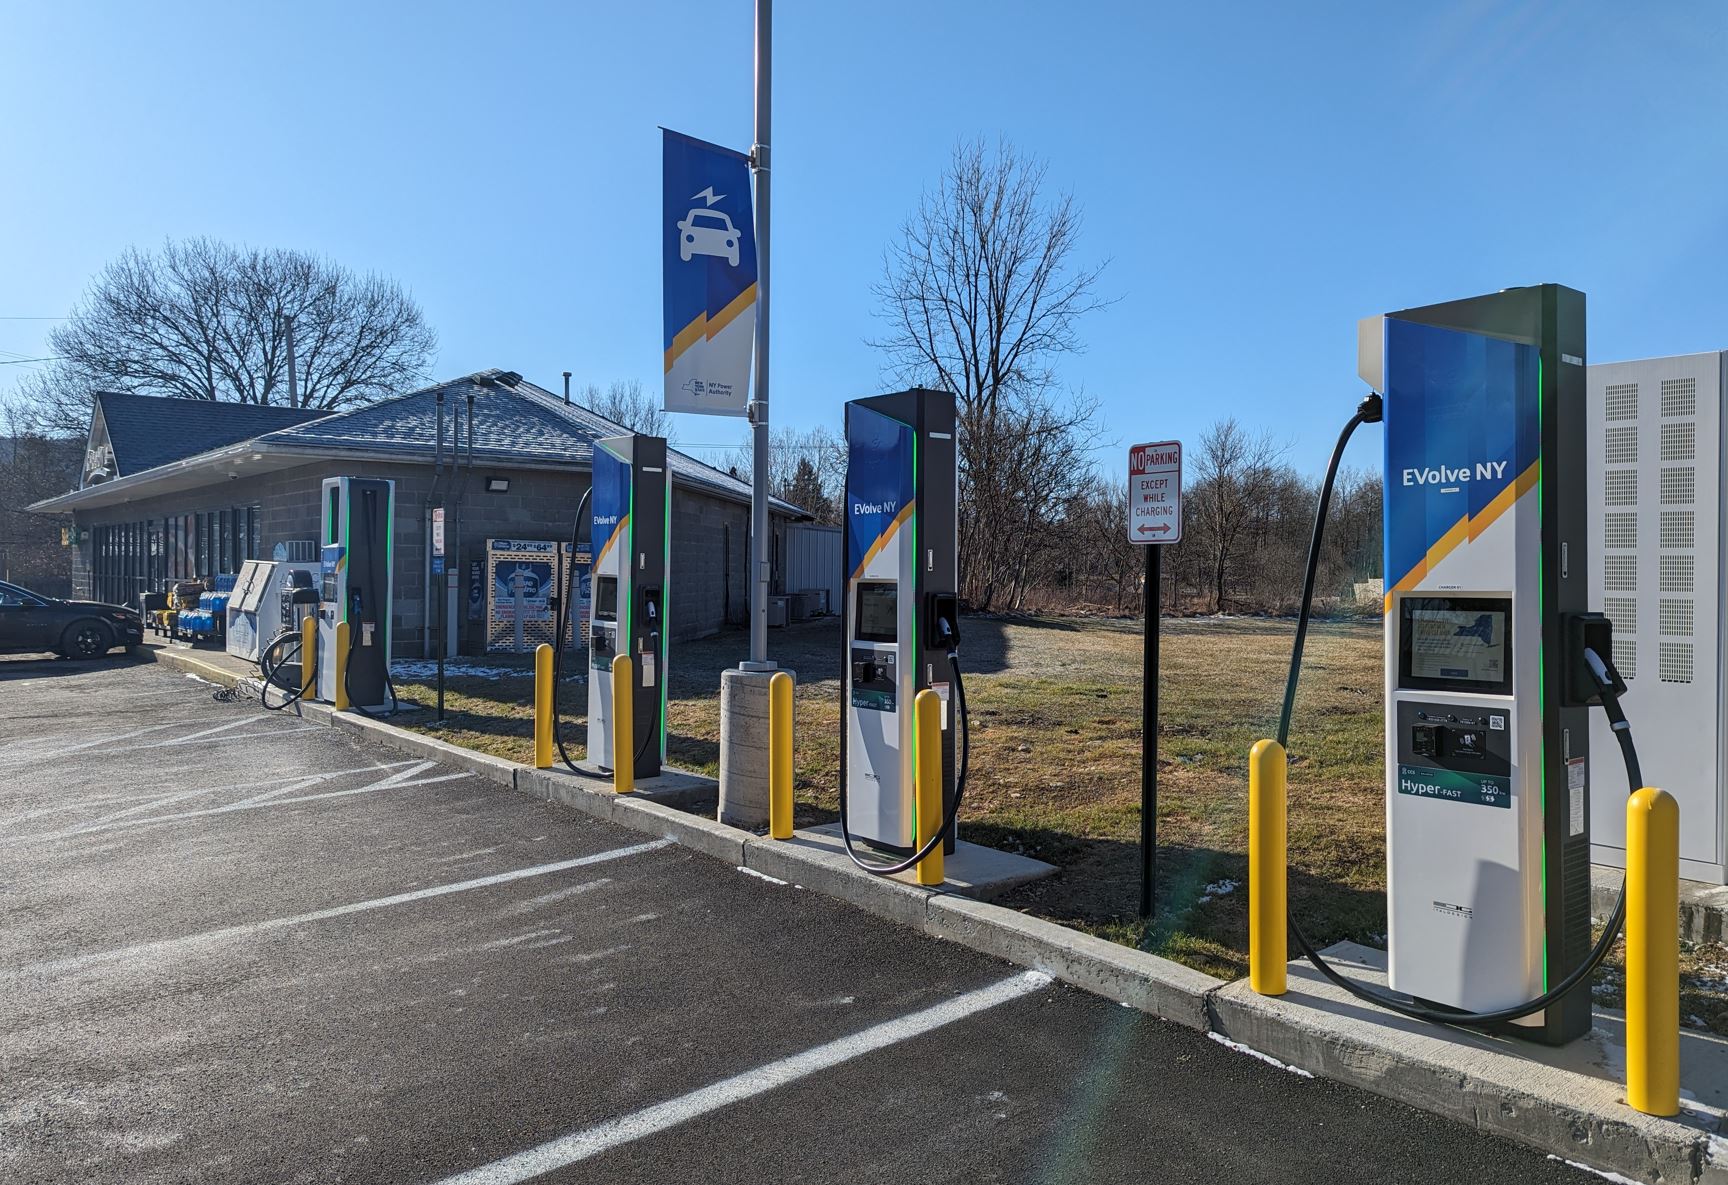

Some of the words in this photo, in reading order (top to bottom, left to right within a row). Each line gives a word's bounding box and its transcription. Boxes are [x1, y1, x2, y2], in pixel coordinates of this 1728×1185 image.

[1131, 452, 1144, 471] NO
[1146, 451, 1178, 466] PARKING
[1403, 464, 1471, 486] EVolve
[1476, 461, 1507, 480] NY
[1141, 479, 1168, 490] EXCEPT
[1143, 493, 1166, 503] WHILE
[854, 502, 882, 515] EVolve
[883, 501, 897, 513] NY
[1135, 505, 1173, 517] CHARGING
[1480, 784, 1499, 795] 350
